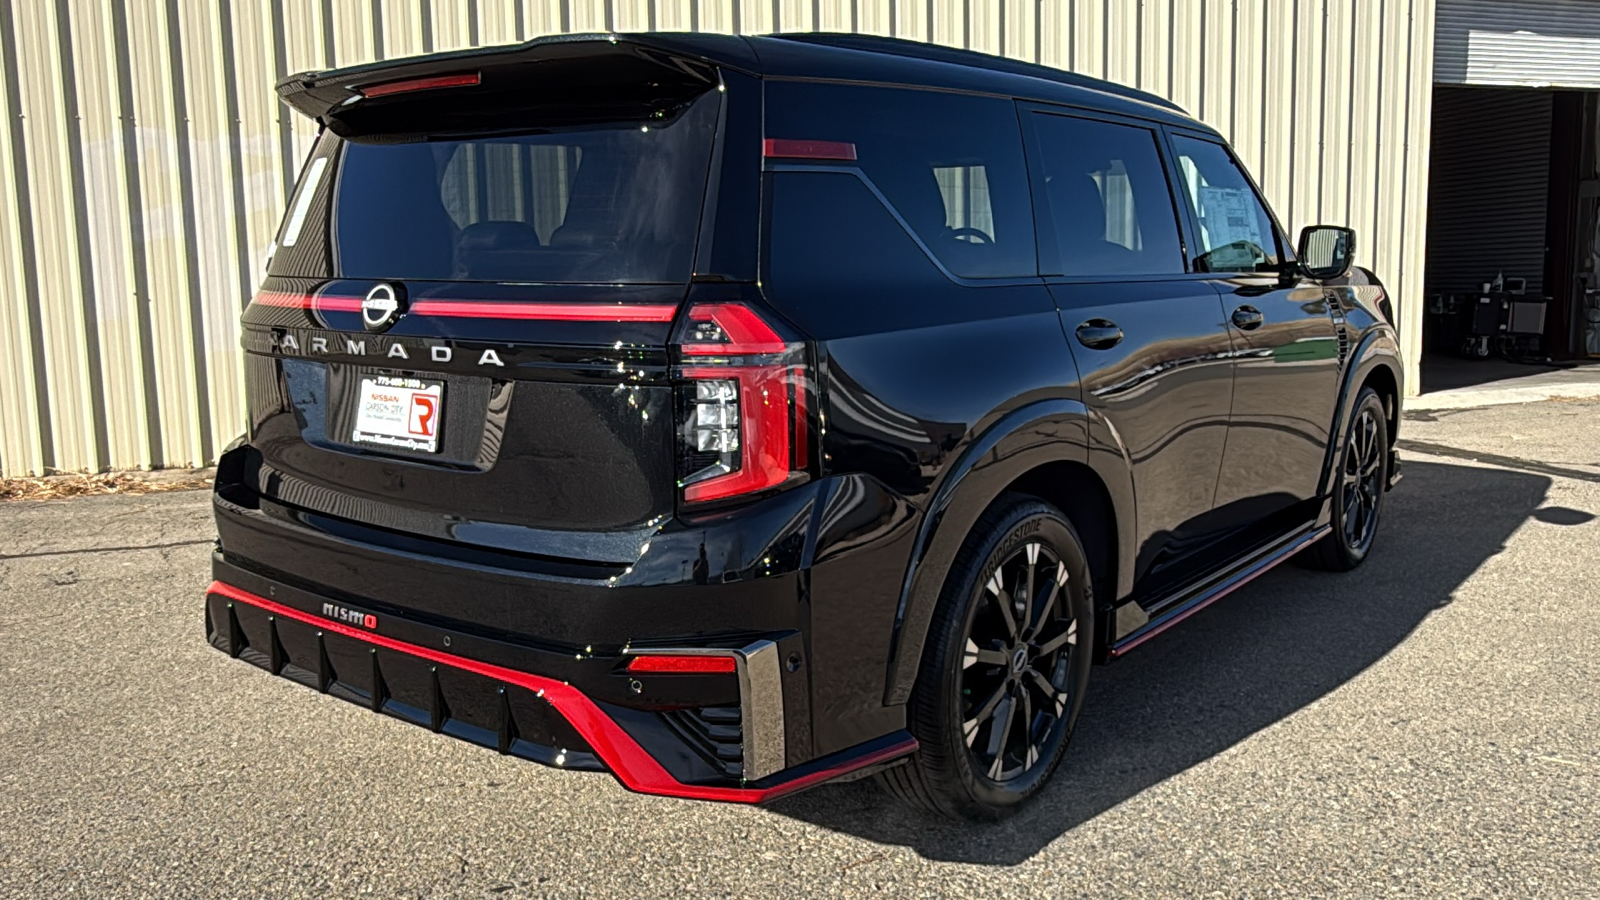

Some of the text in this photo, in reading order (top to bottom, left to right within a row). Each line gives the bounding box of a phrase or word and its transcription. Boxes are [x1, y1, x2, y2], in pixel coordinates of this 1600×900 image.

[283, 334, 504, 367] ARMADA
[371, 393, 400, 403] NISSAN
[414, 397, 434, 435] R
